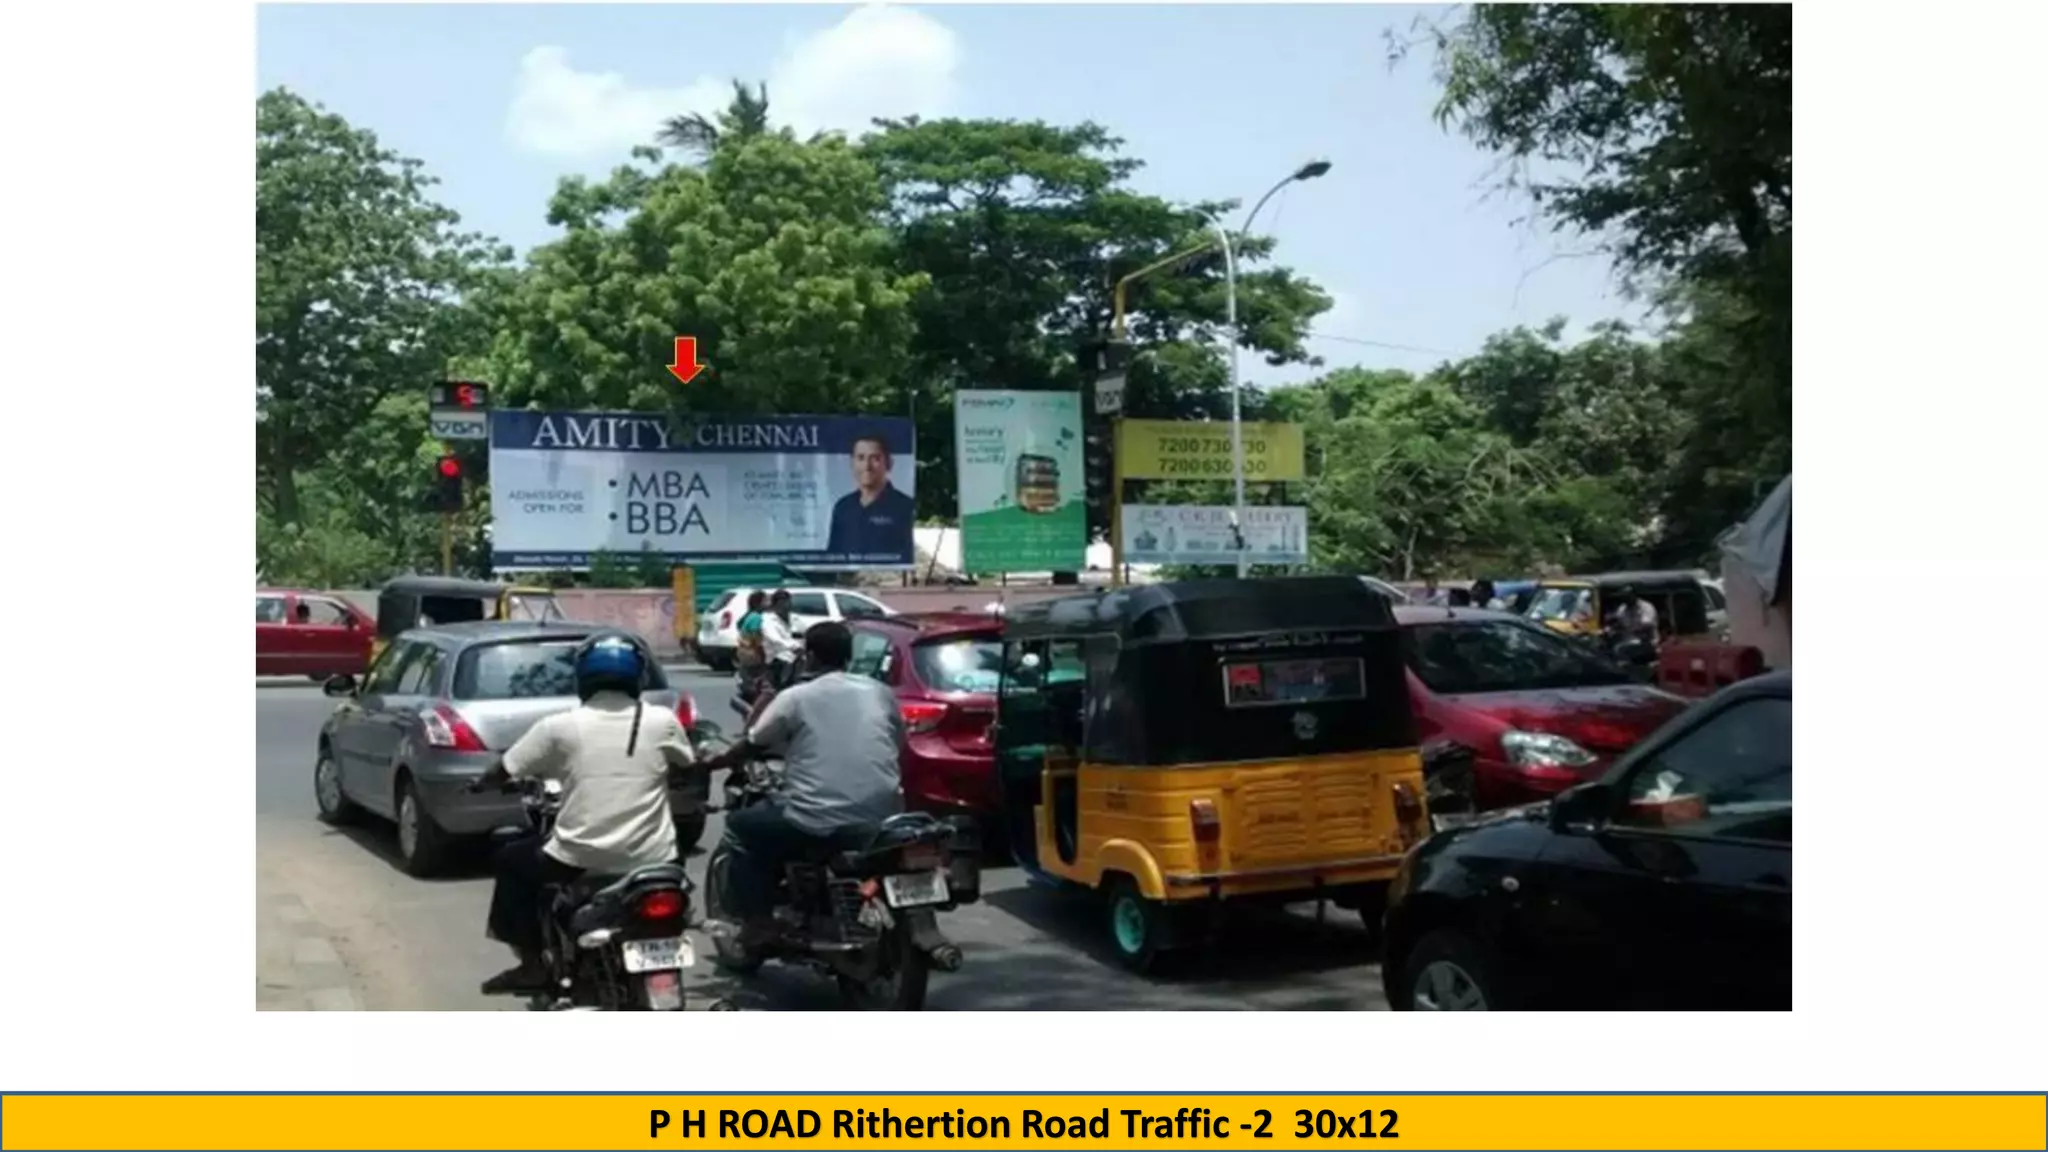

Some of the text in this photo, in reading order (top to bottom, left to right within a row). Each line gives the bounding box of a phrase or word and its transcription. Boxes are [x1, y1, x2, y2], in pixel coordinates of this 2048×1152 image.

[531, 414, 820, 449] AMITY CHENNAI
[508, 490, 585, 501] ADMISSIONS
[627, 470, 710, 500] MBA
[522, 502, 585, 514] OPEN FOR
[626, 501, 710, 535] BBA
